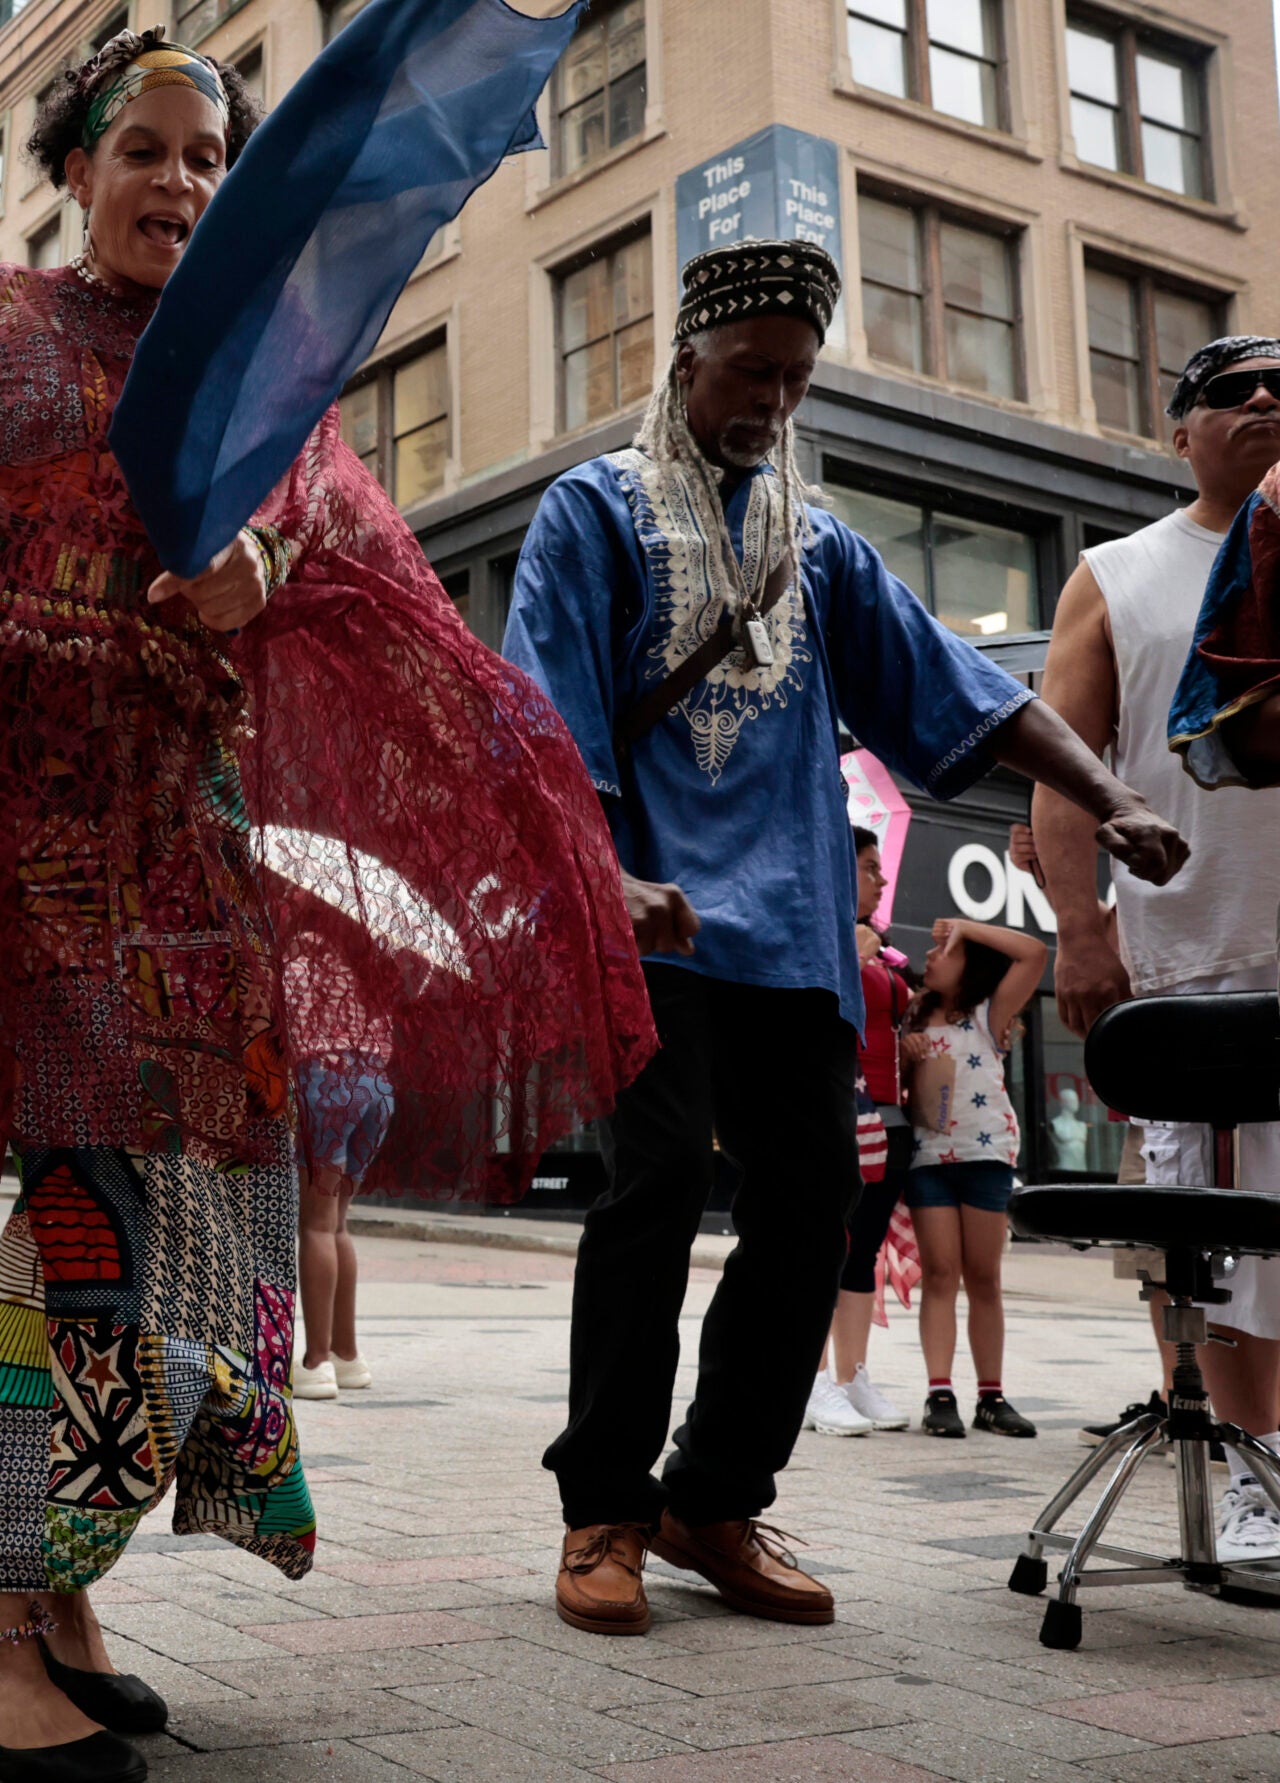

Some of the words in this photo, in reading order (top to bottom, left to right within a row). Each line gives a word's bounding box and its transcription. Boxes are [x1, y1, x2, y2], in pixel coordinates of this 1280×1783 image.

[703, 156, 745, 188] This
[698, 181, 751, 220] Place
[789, 179, 828, 207] This
[709, 212, 742, 241] For
[785, 199, 835, 229] Place
[795, 223, 826, 247] For
[531, 1177, 569, 1190] STREET
